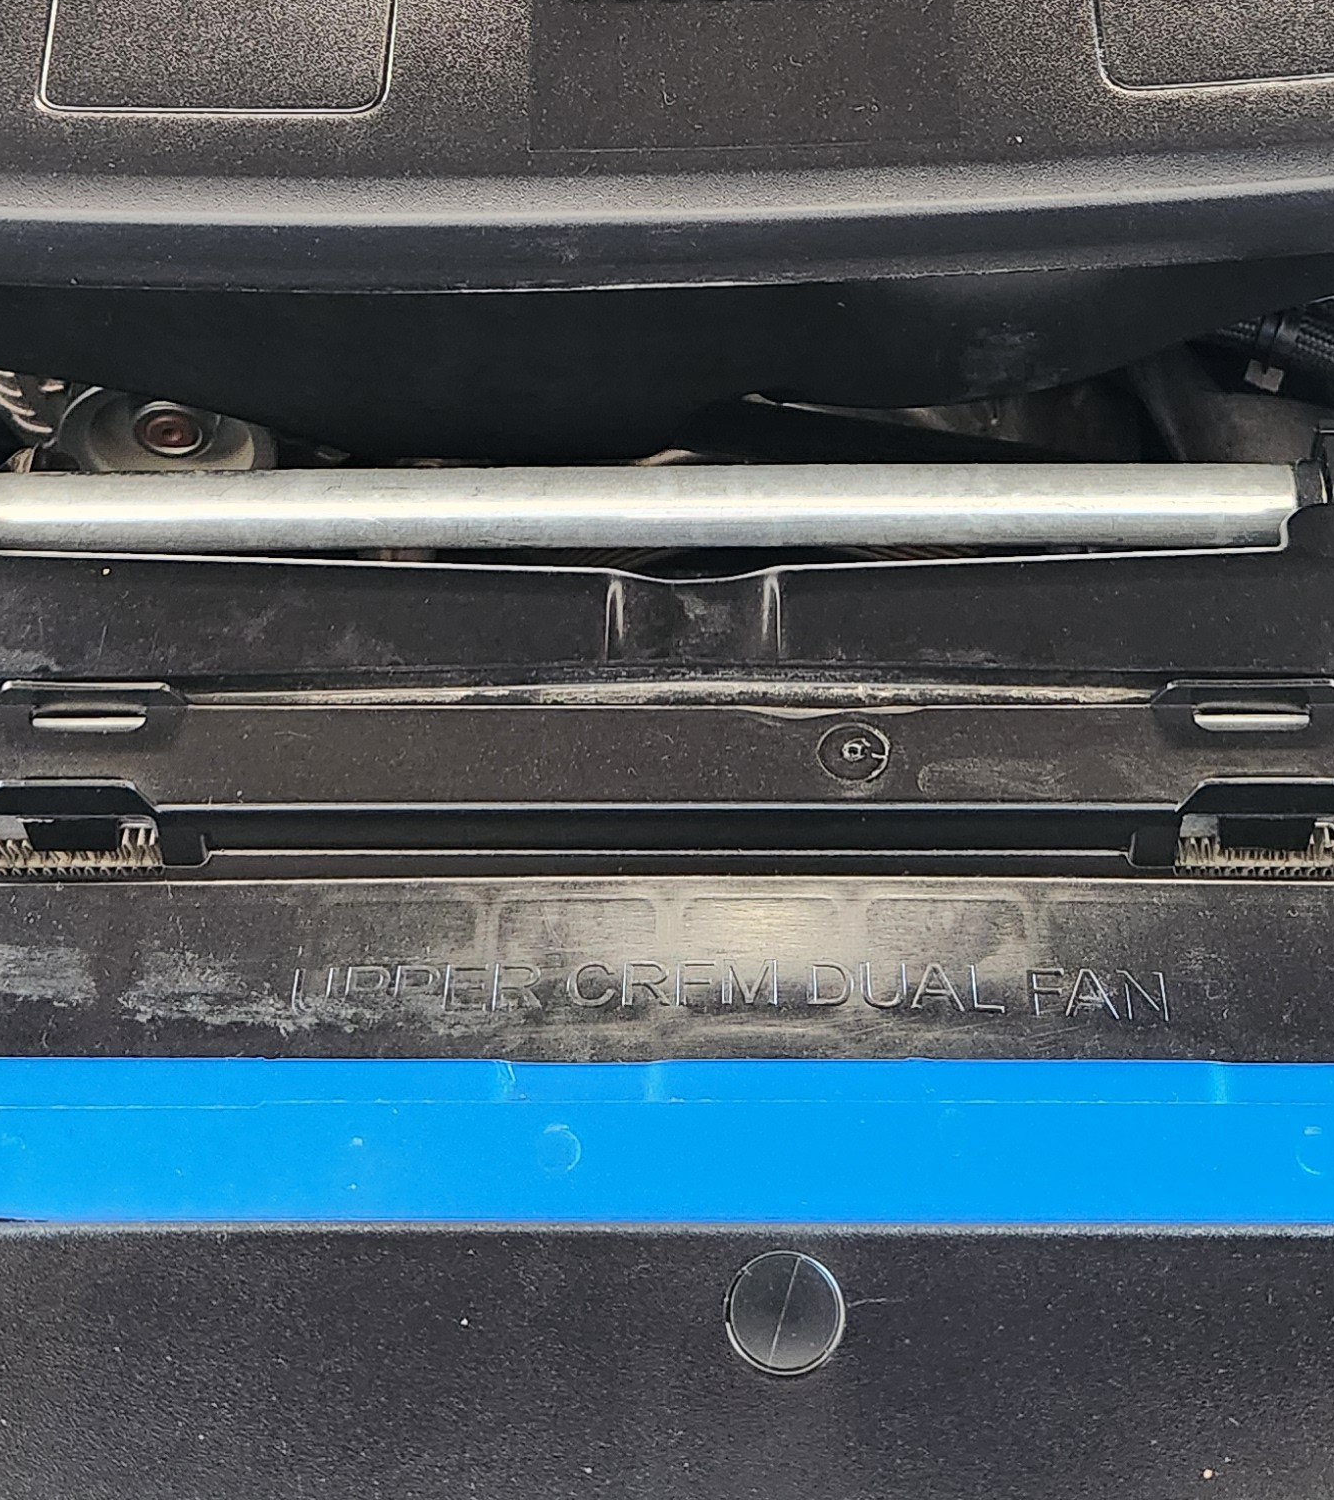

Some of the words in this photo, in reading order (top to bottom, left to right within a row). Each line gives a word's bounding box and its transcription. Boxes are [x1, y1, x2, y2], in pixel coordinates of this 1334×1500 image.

[290, 962, 544, 1015] UPPER
[806, 960, 1005, 1014] DUAL
[1029, 966, 1171, 1022] FAN
